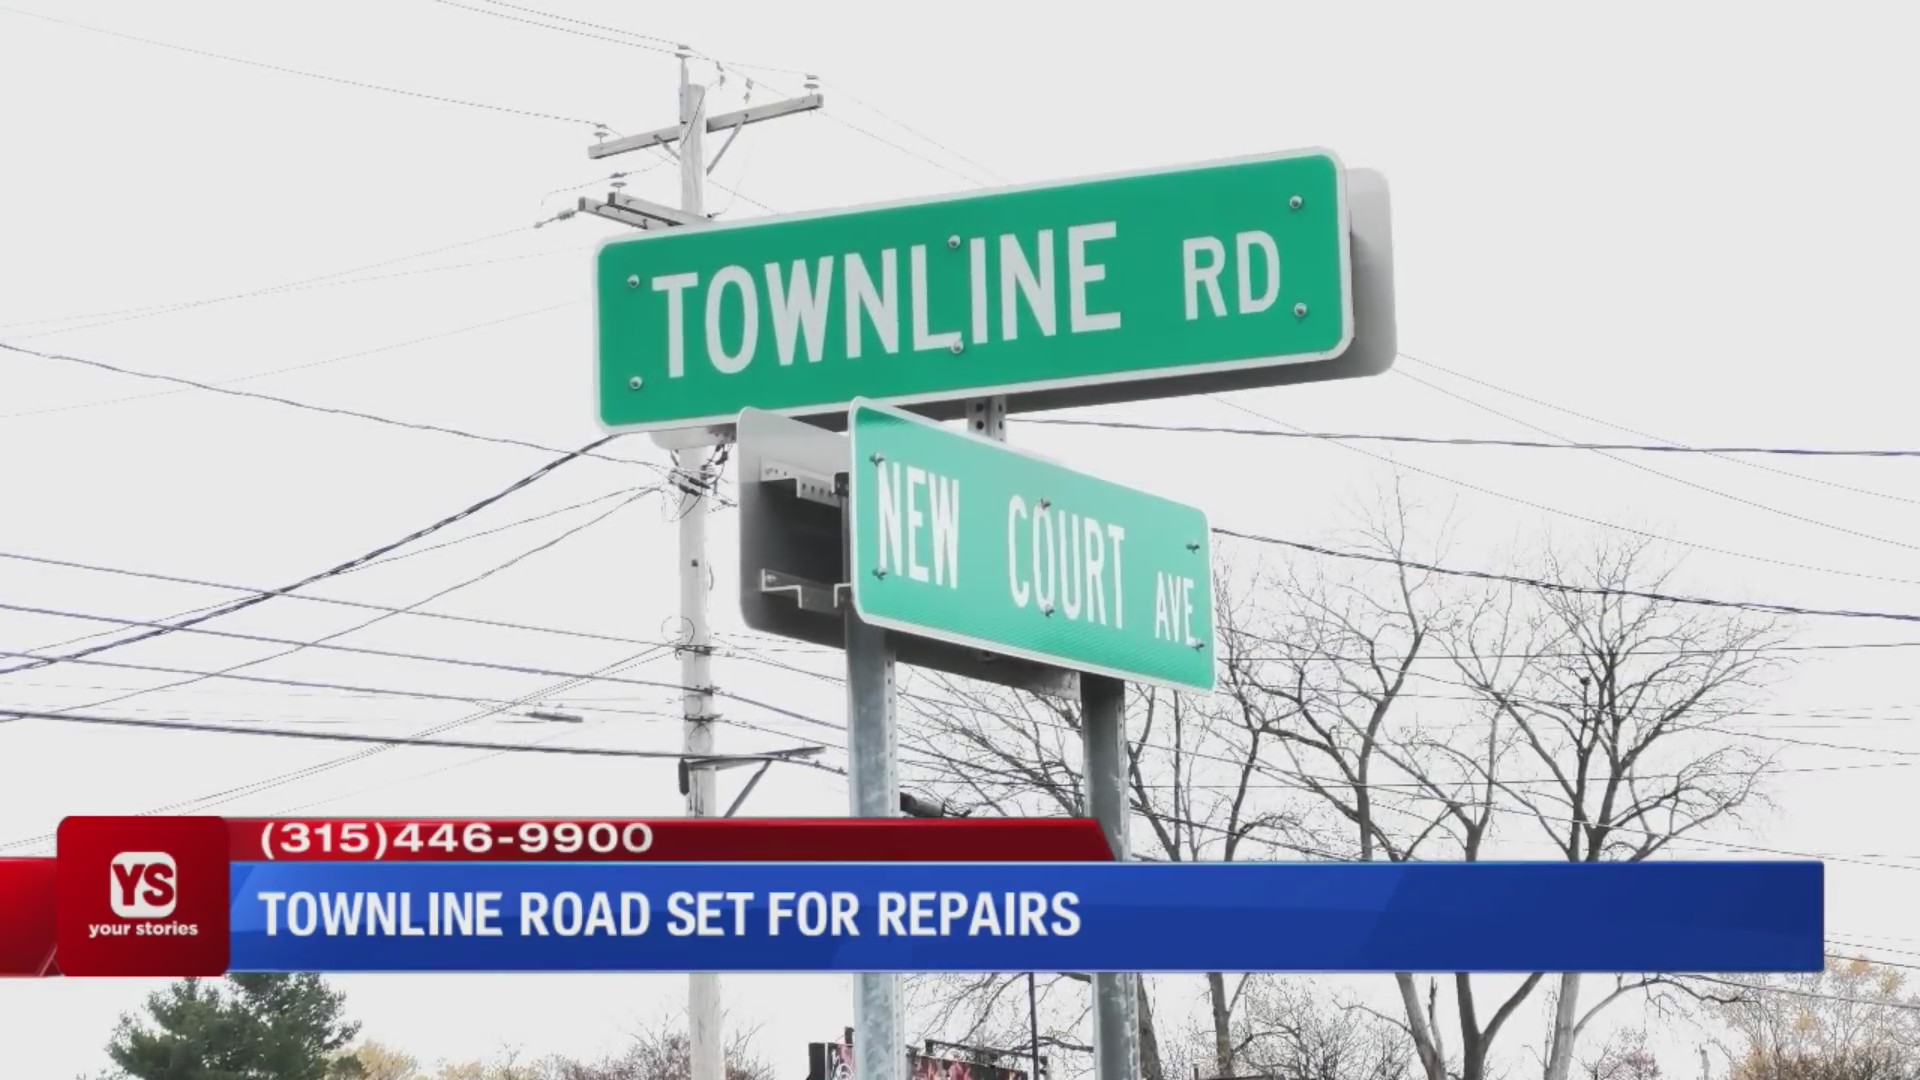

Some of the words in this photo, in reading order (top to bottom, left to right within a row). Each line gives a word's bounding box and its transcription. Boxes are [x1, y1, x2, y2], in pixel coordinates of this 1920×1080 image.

[652, 221, 1121, 378] TOWNLINE
[1183, 230, 1280, 320] RD
[877, 462, 959, 589] NEW
[1008, 495, 1125, 629] COURT
[1155, 571, 1197, 644] AVE
